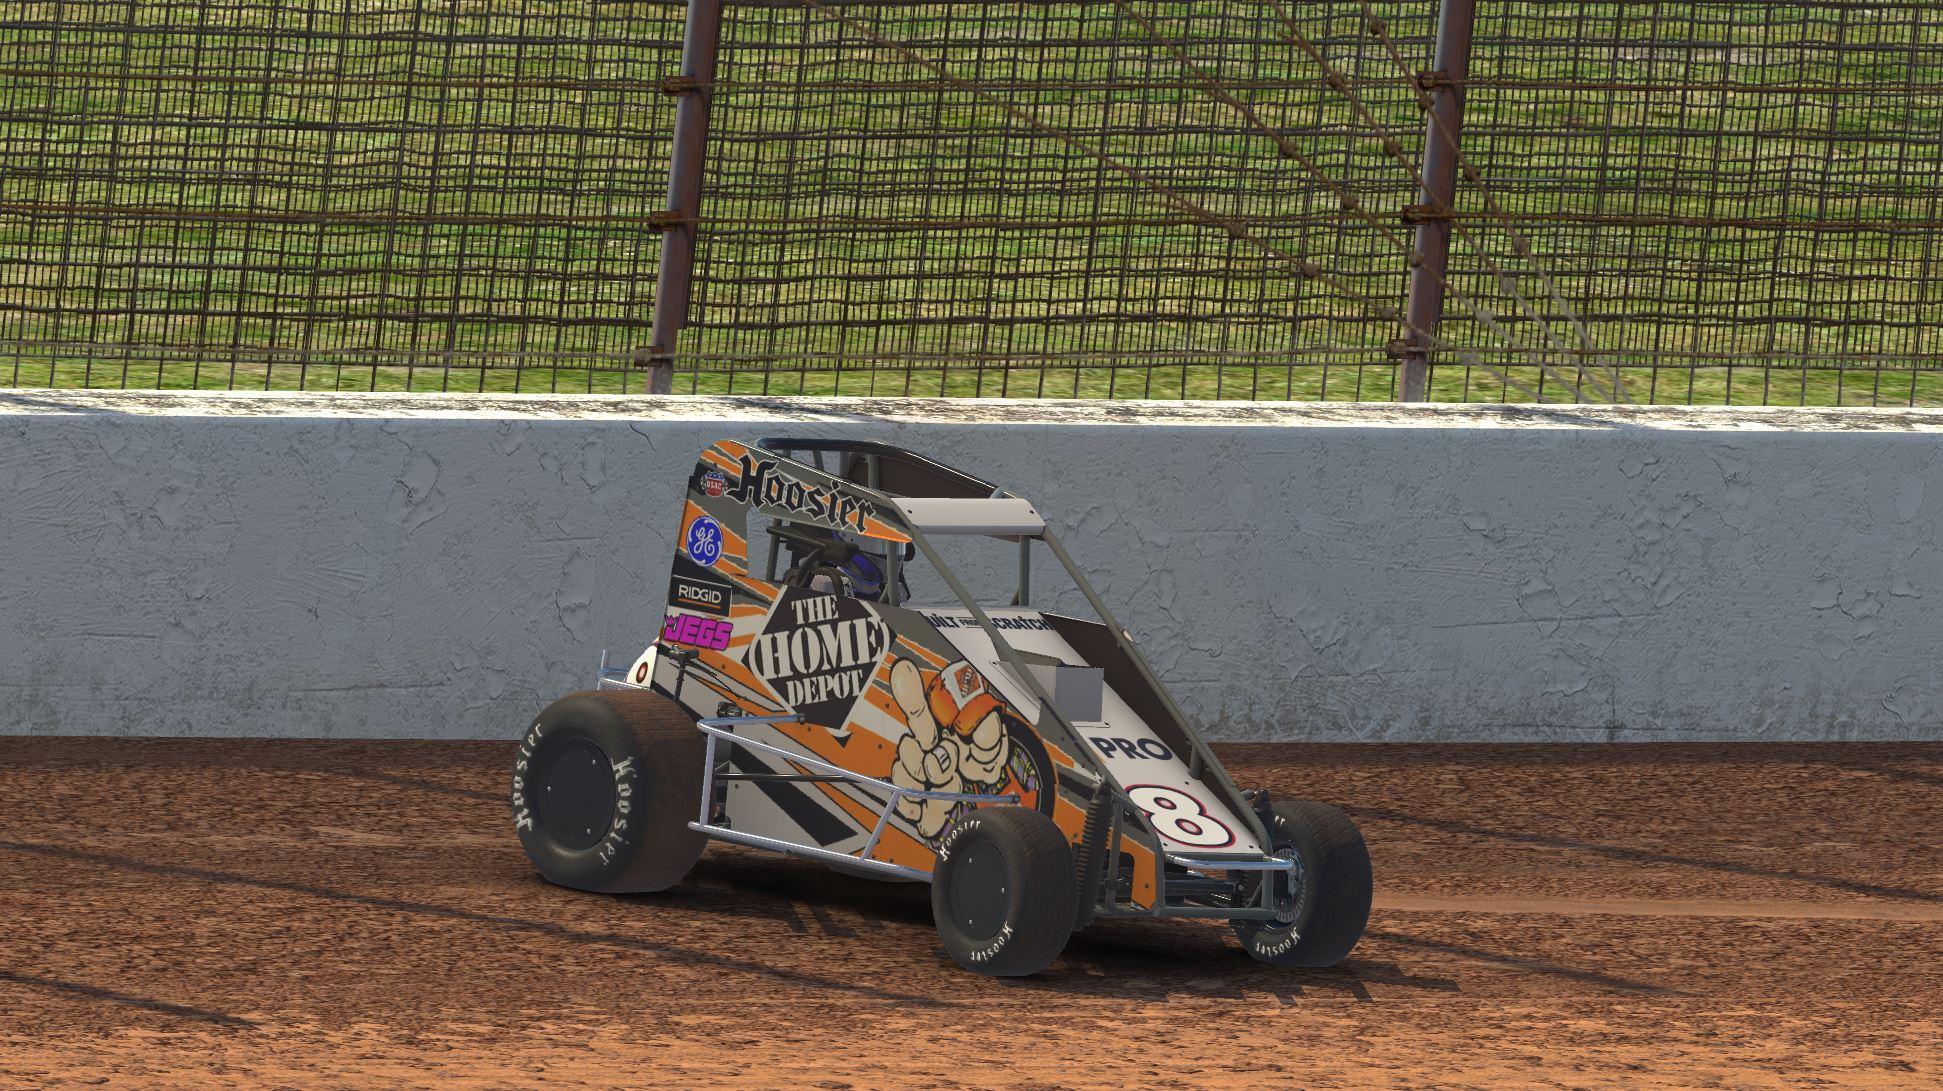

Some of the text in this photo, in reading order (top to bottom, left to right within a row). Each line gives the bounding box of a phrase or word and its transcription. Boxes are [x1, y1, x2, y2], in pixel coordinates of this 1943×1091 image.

[725, 454, 876, 535] Hoosier
[678, 584, 722, 603] RIDGID
[791, 595, 839, 625] THE
[664, 613, 733, 651] JEGS
[925, 612, 961, 628] UILT
[757, 616, 884, 680] HOME
[785, 669, 864, 707] DEPOT
[1089, 737, 1173, 761] PRO
[1124, 783, 1237, 849] 8
